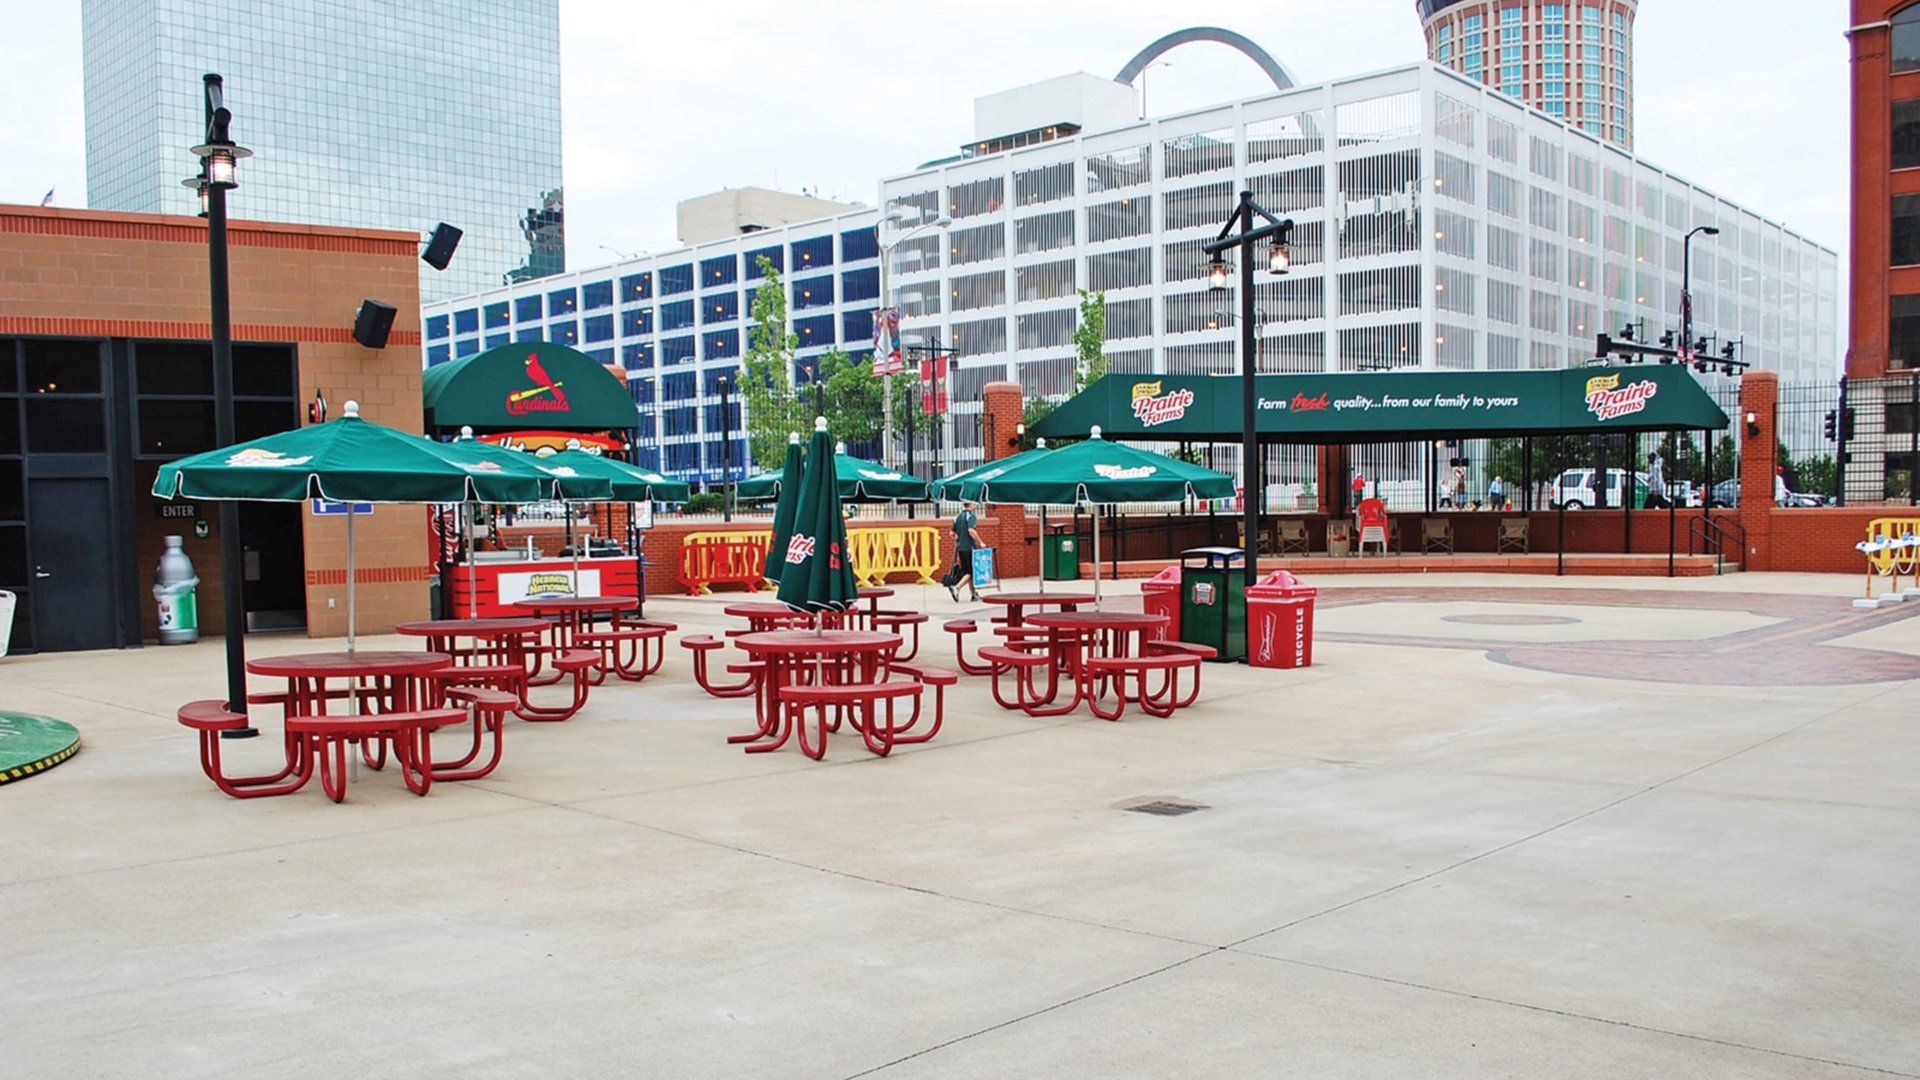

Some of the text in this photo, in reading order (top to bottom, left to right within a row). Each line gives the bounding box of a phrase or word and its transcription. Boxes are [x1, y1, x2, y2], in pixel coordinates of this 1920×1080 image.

[506, 390, 570, 416] Cardinals
[1132, 388, 1194, 417] Prairie
[1257, 397, 1286, 410] Farm
[1290, 392, 1330, 411] fresh
[1412, 397, 1432, 408] our
[1434, 393, 1471, 410] family
[1472, 396, 1485, 407] to
[1486, 397, 1519, 410] yours
[1586, 381, 1656, 410] Prairie
[1142, 407, 1184, 427] Farms
[1597, 400, 1644, 419] Farms
[162, 505, 195, 517] ENTER
[529, 584, 570, 594] NATIONAL
[1295, 607, 1304, 667] RECYCLE
